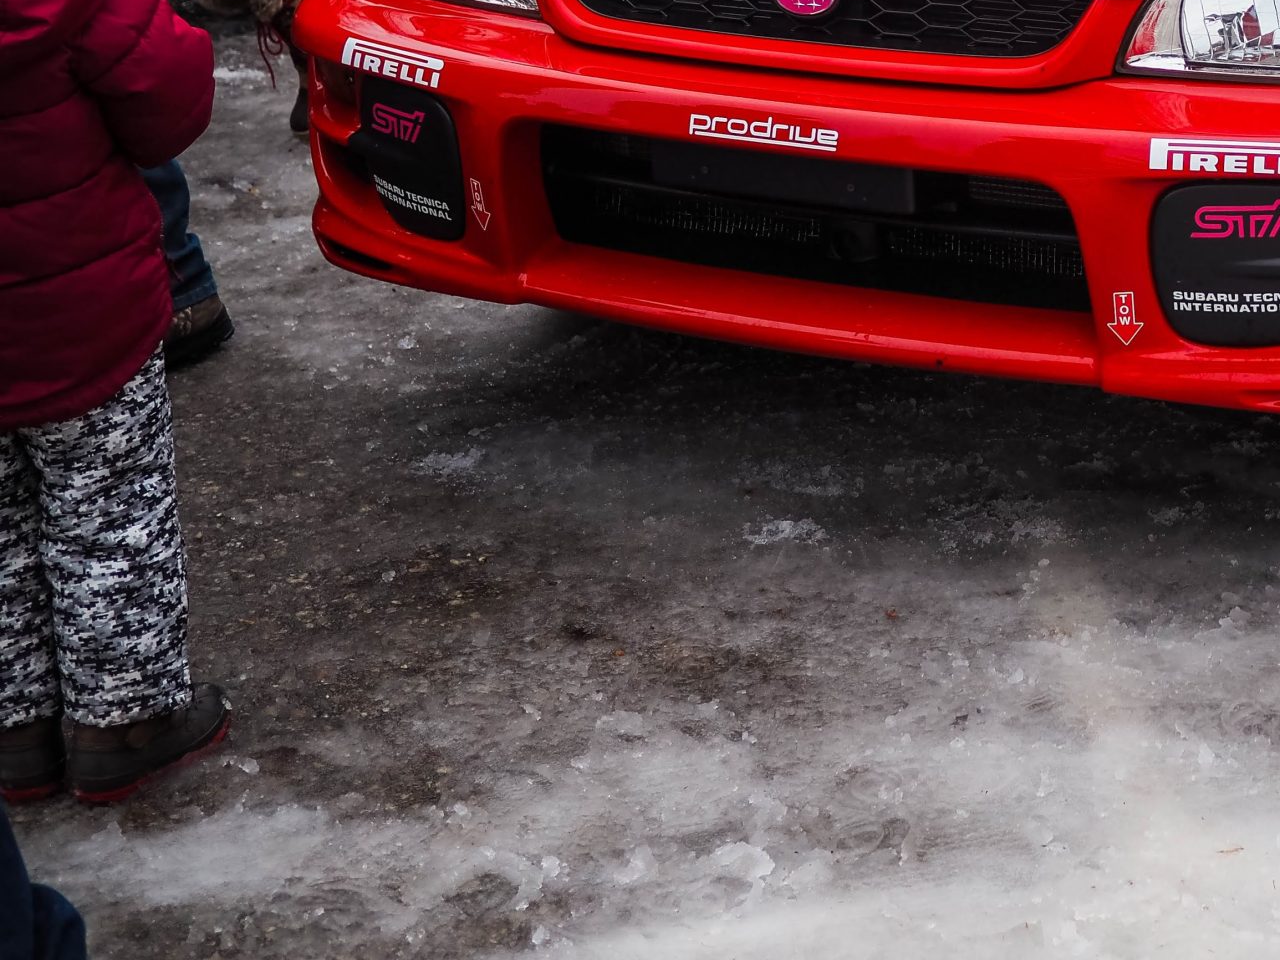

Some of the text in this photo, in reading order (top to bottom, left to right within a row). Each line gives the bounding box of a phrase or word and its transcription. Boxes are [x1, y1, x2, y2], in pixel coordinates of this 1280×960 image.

[341, 37, 444, 88] PIRELLI
[689, 113, 839, 151] prodrive
[374, 174, 450, 211] SUBARU TECNICA
[375, 184, 452, 221] INTERNATIONAL
[472, 181, 483, 212] TOW
[1119, 294, 1131, 326] TOW
[1173, 290, 1239, 302] SUBARU
